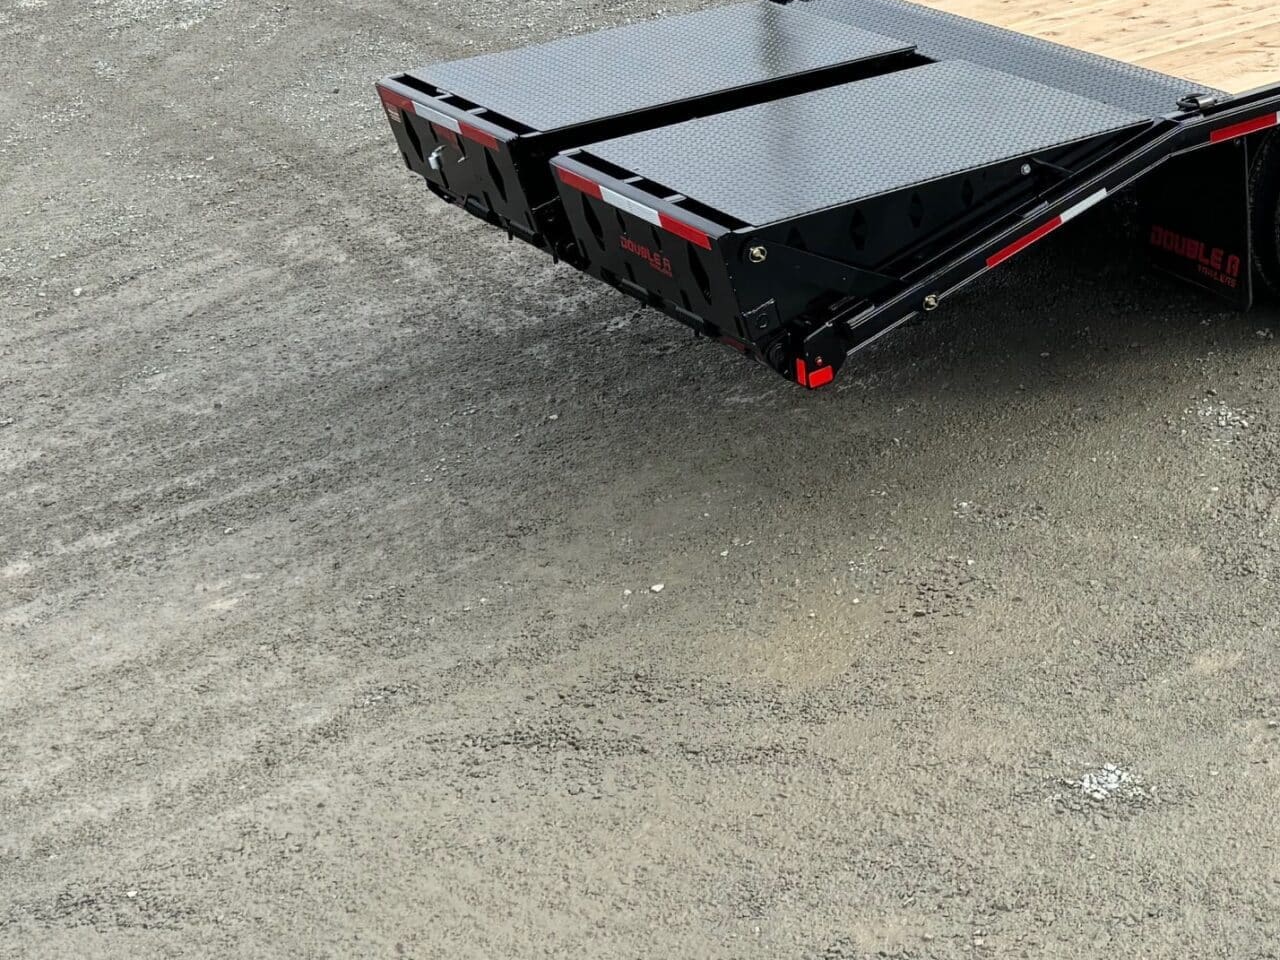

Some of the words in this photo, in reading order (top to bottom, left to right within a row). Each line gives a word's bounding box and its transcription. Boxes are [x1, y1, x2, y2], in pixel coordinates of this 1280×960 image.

[618, 235, 661, 266] DOUBLE
[662, 256, 672, 272] A
[1150, 224, 1224, 270] DOUBLE
[1226, 253, 1240, 277] A
